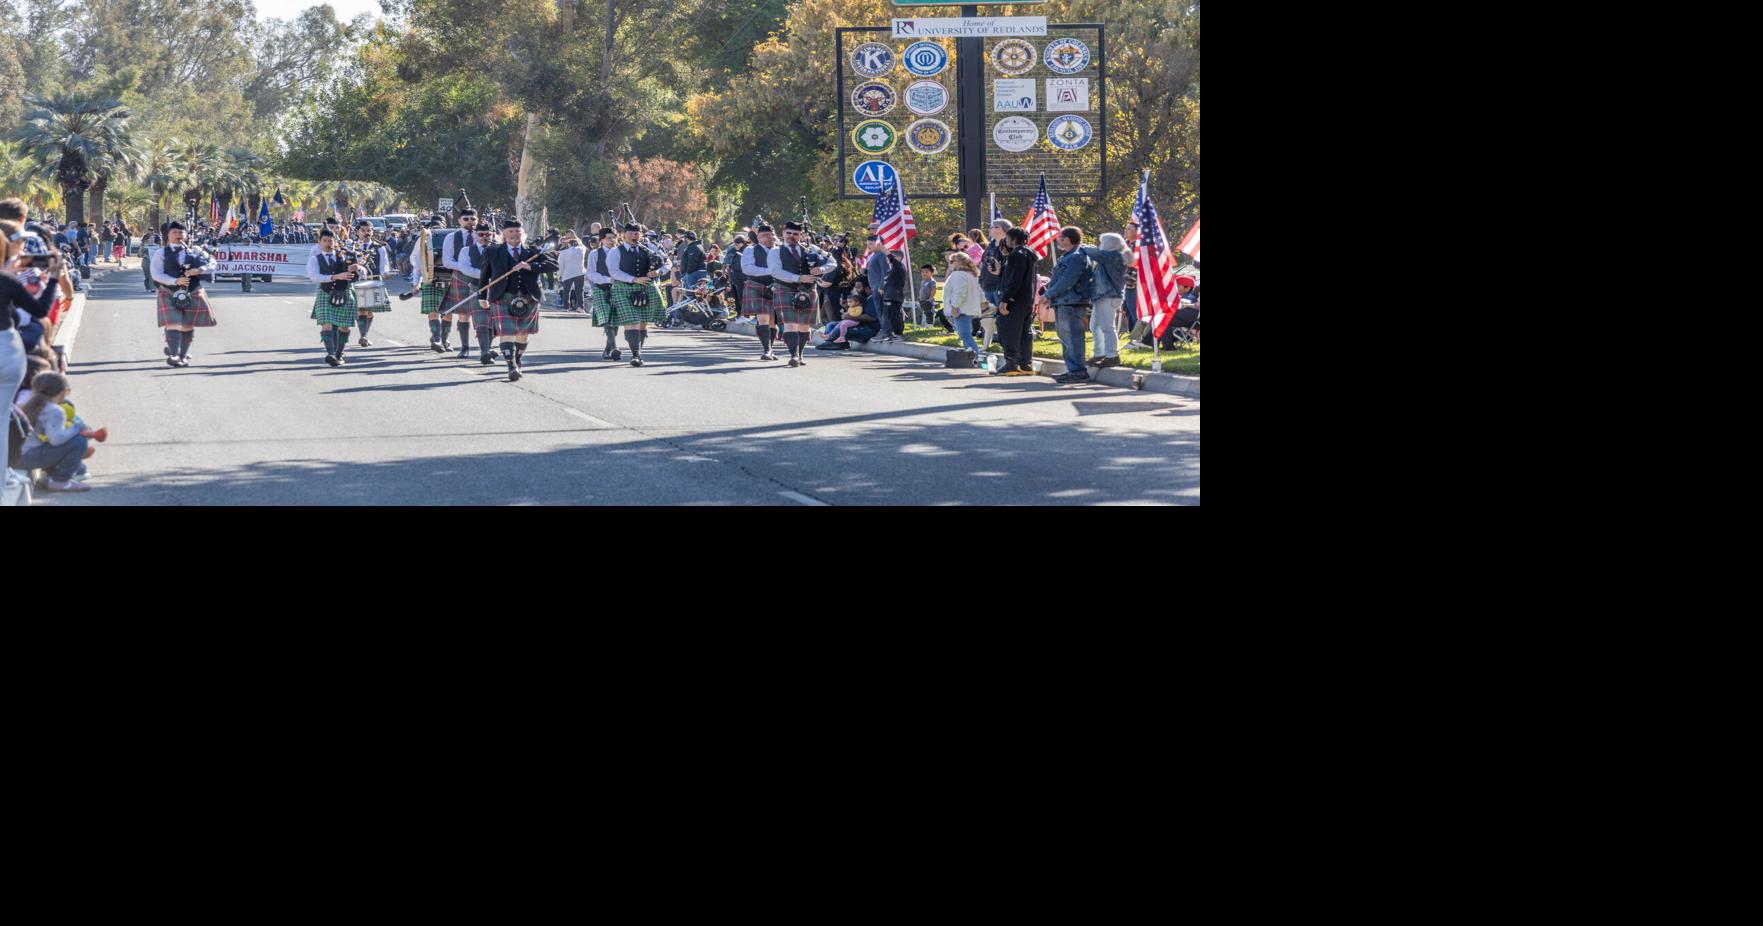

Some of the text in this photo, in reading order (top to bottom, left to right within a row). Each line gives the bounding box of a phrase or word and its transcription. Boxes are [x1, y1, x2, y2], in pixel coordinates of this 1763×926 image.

[918, 27, 974, 35] UNIVERSITY
[993, 26, 1045, 34] REDLANDS
[864, 51, 883, 69] K
[860, 165, 893, 182] AL
[231, 251, 289, 262] MARSHAL
[232, 263, 276, 272] JACKSON
